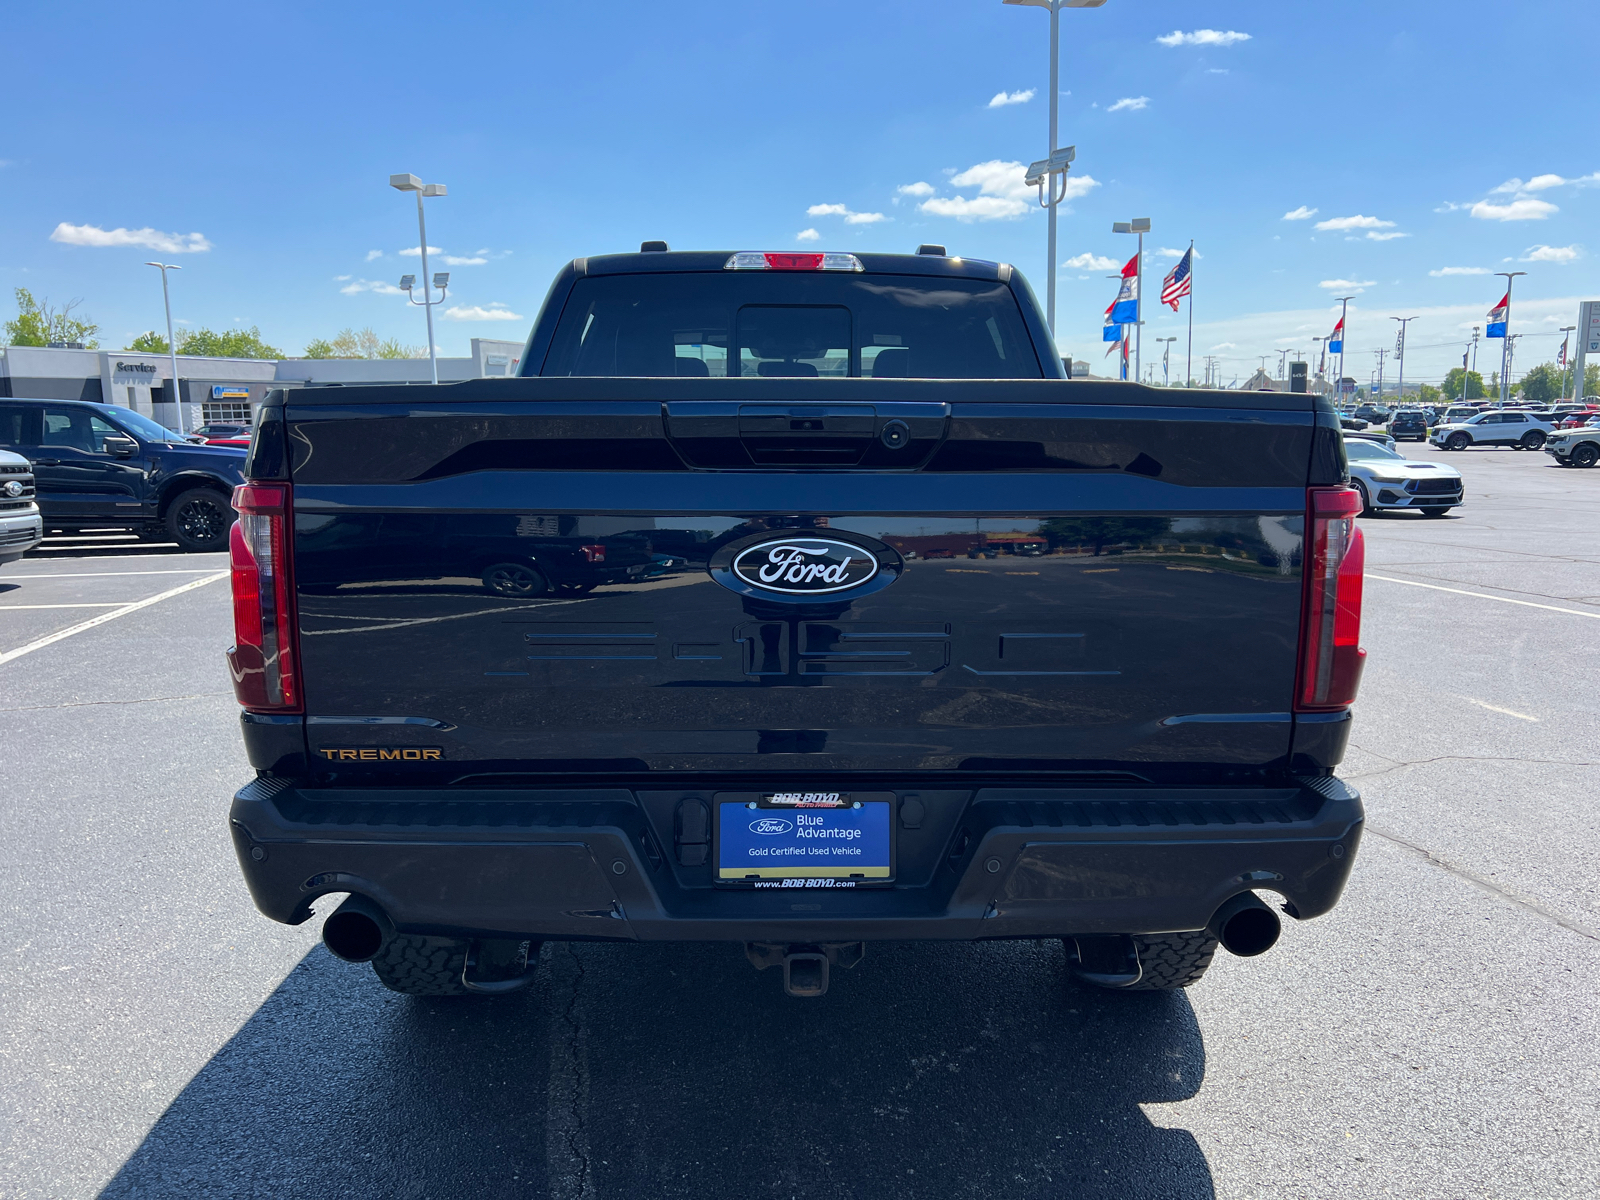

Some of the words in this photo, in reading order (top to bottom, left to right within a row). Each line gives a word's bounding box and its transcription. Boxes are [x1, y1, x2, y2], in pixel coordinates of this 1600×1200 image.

[116, 361, 157, 372] Service
[759, 545, 851, 583] Ford
[320, 749, 441, 760] TREMOR
[757, 820, 785, 832] Ford
[796, 814, 824, 826] Blue
[796, 827, 862, 840] Advantage
[748, 847, 768, 856] Gold
[770, 846, 806, 855] Certified
[808, 847, 830, 855] Used
[831, 846, 862, 855] Vehicle
